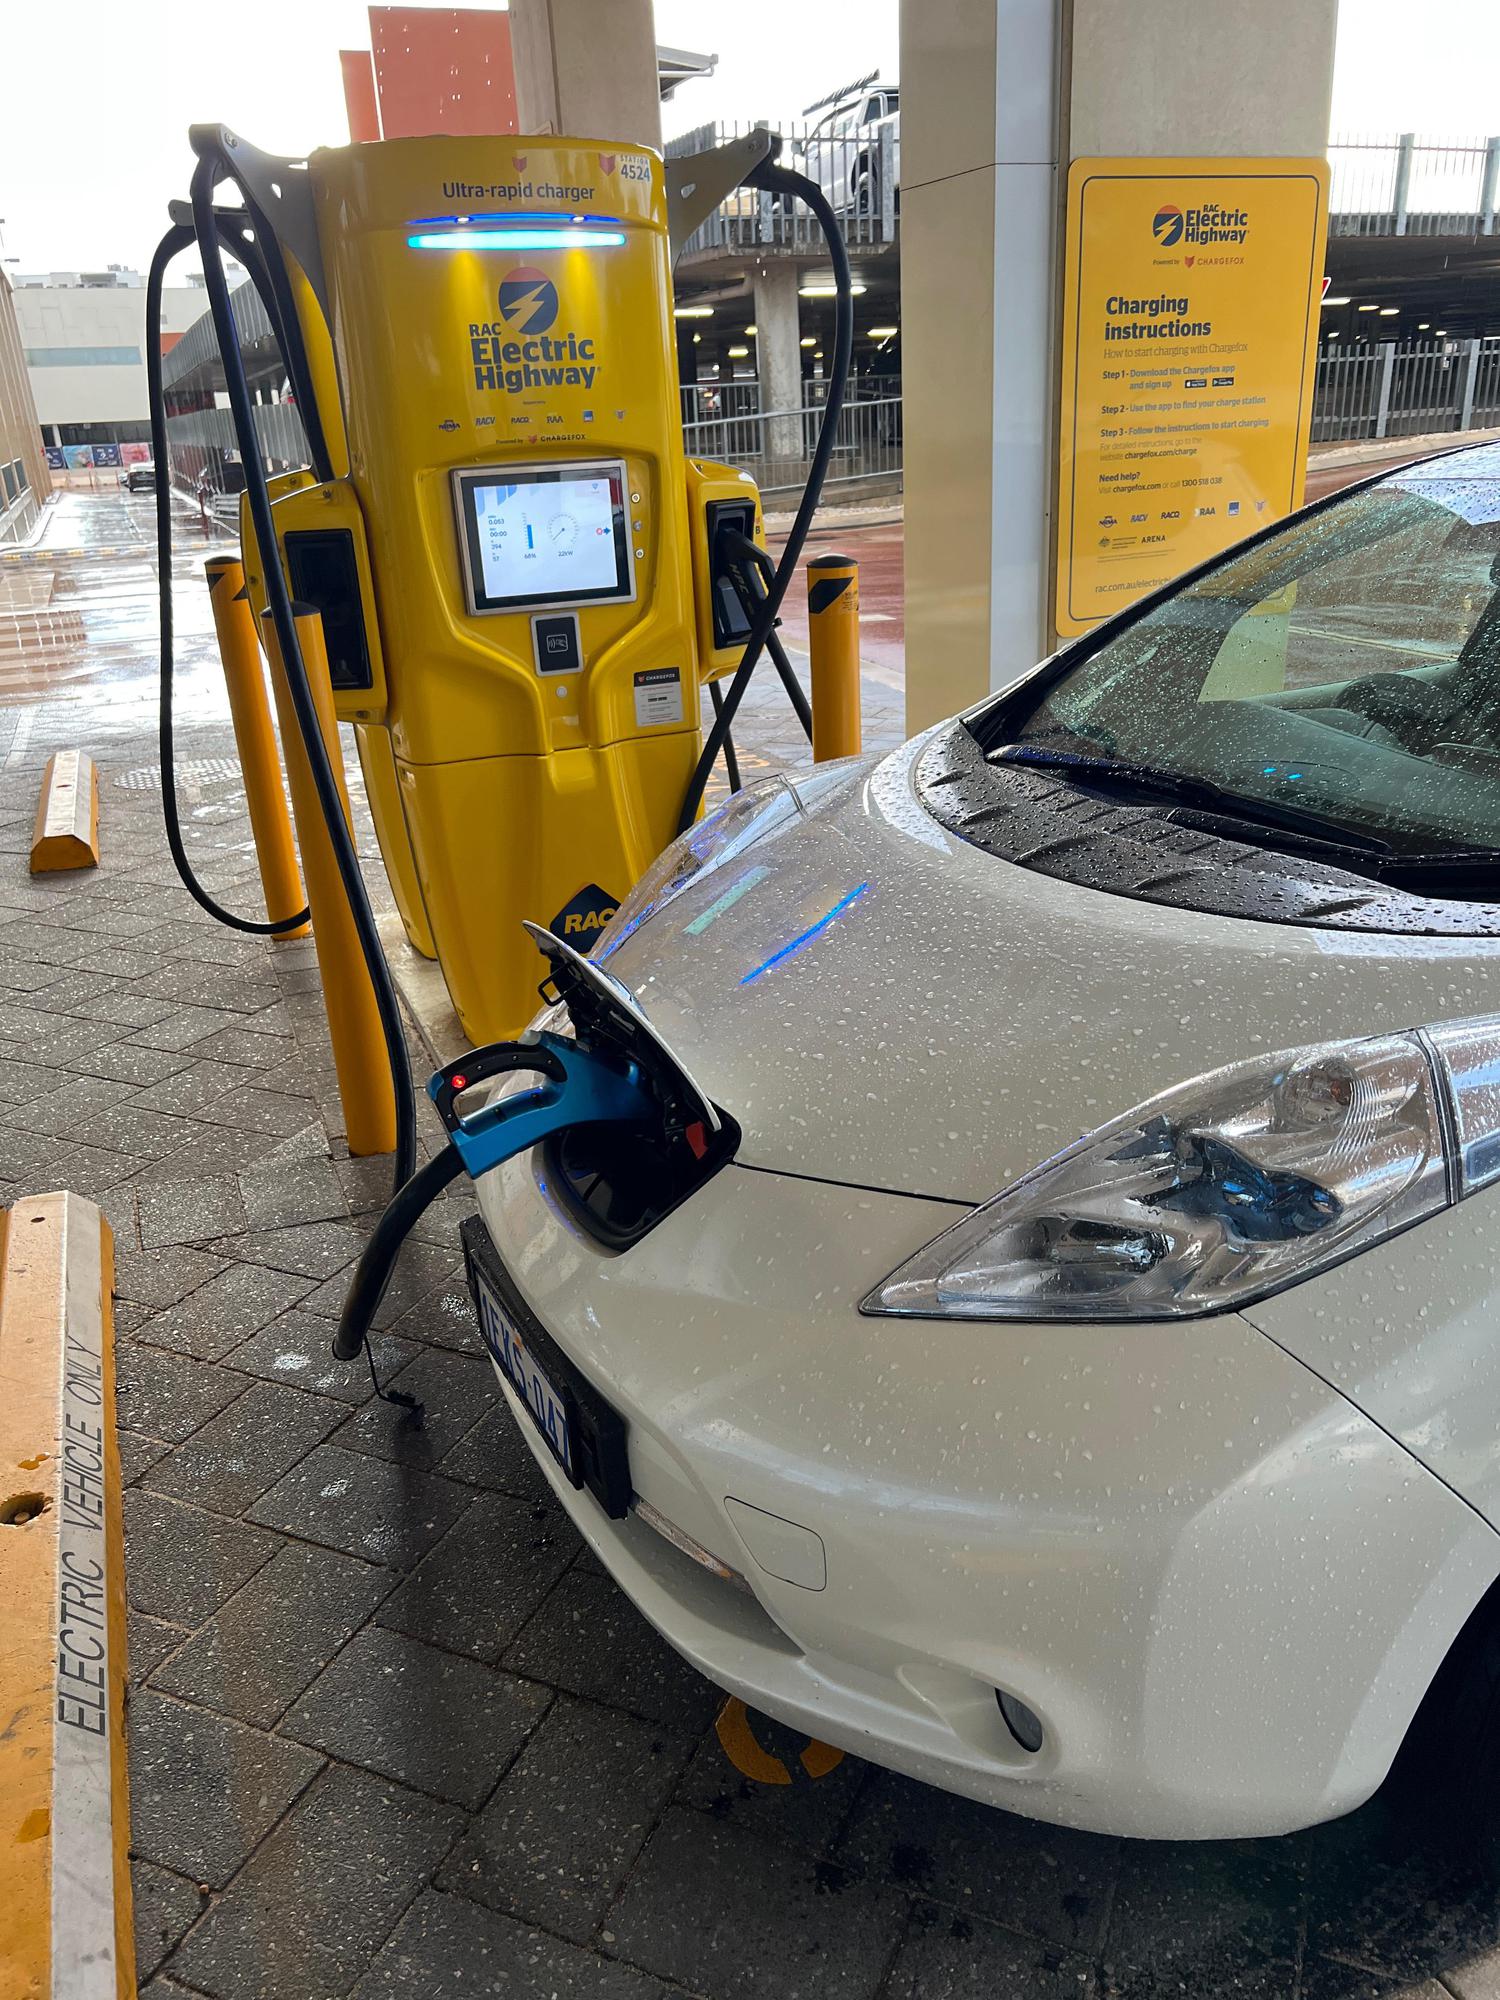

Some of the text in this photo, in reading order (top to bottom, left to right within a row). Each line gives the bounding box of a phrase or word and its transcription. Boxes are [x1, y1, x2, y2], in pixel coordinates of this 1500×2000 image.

[621, 164, 650, 182] 4524
[443, 182, 595, 201] Ultra-rapid charger
[1203, 204, 1219, 212] RAC
[1186, 209, 1248, 226] Electric
[1185, 227, 1246, 245] Highway
[1197, 257, 1245, 265] CHARGEFOX
[1106, 294, 1188, 317] Charging
[469, 322, 501, 337] RAC
[1105, 319, 1211, 340] instructions
[471, 332, 594, 365] Electric
[1104, 343, 1248, 359] How to start charging with Chargefox
[474, 364, 595, 394] Highway
[1103, 370, 1120, 380] Step
[1130, 368, 1168, 377] Download
[1169, 367, 1182, 375] the
[1183, 365, 1219, 375] Chargefox
[1221, 365, 1235, 374] app
[1130, 380, 1172, 390] and sign up
[1101, 405, 1118, 415] Step
[1145, 403, 1157, 411] the
[1158, 403, 1173, 412] app
[1183, 400, 1196, 408] find
[1199, 400, 1214, 409] your
[1216, 398, 1240, 407] charge
[1242, 396, 1265, 405] station
[1101, 428, 1118, 438] Step
[1128, 426, 1153, 435] Follow
[1154, 425, 1167, 433] the
[1168, 423, 1210, 432] instructions
[1220, 420, 1237, 429] start
[1238, 418, 1269, 428] charging
[540, 433, 586, 442] CHARGEFOX
[1124, 448, 1198, 460] chargefox.com/charge
[1099, 471, 1141, 482] Need help?
[1112, 483, 1161, 493] chargefox.com
[1182, 479, 1197, 487] 1300
[1161, 510, 1180, 519] RACQ
[1199, 507, 1216, 516] RAA
[1141, 535, 1166, 544] ARENA
[564, 908, 617, 934] RAC
[58, 1335, 106, 1737] ELECTRIC VEHICLE ONLY
